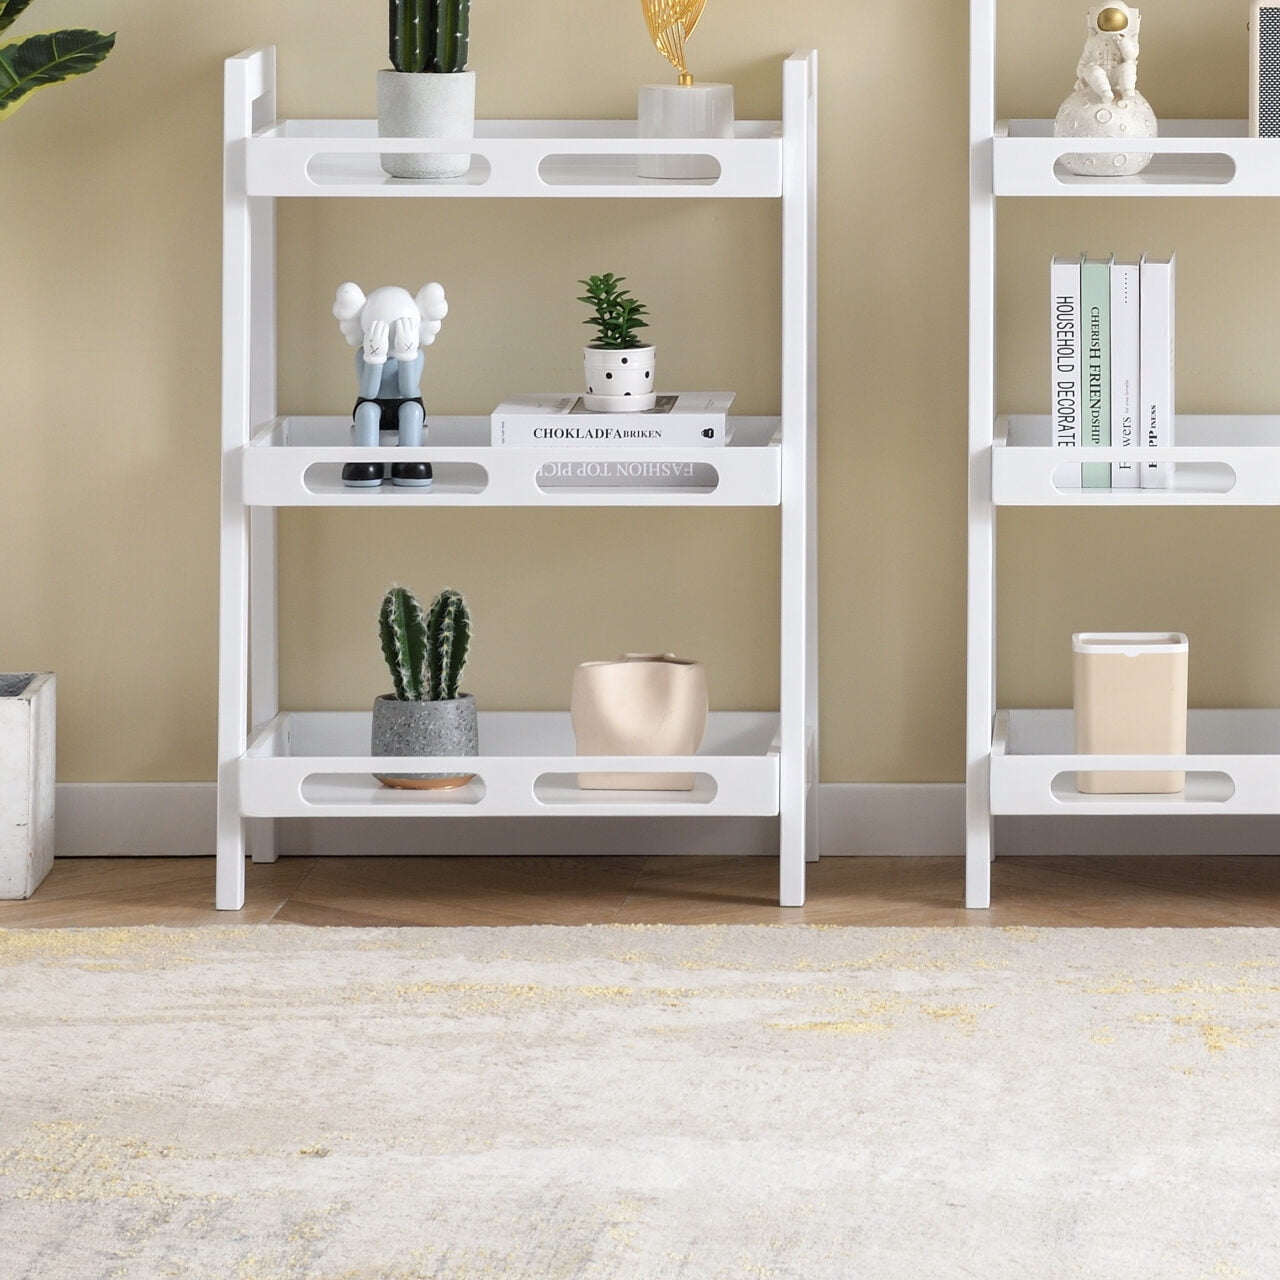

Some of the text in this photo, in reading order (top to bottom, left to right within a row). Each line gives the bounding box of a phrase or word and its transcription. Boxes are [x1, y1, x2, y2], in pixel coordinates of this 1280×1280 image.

[1056, 296, 1076, 447] HOUSEHOLD DECORATE
[1089, 306, 1102, 445] CHERISH FRIENDSHIP
[533, 428, 662, 439] CHOKLADFABRIKEN
[576, 462, 612, 477] TOP
[616, 462, 695, 477] FASHION
